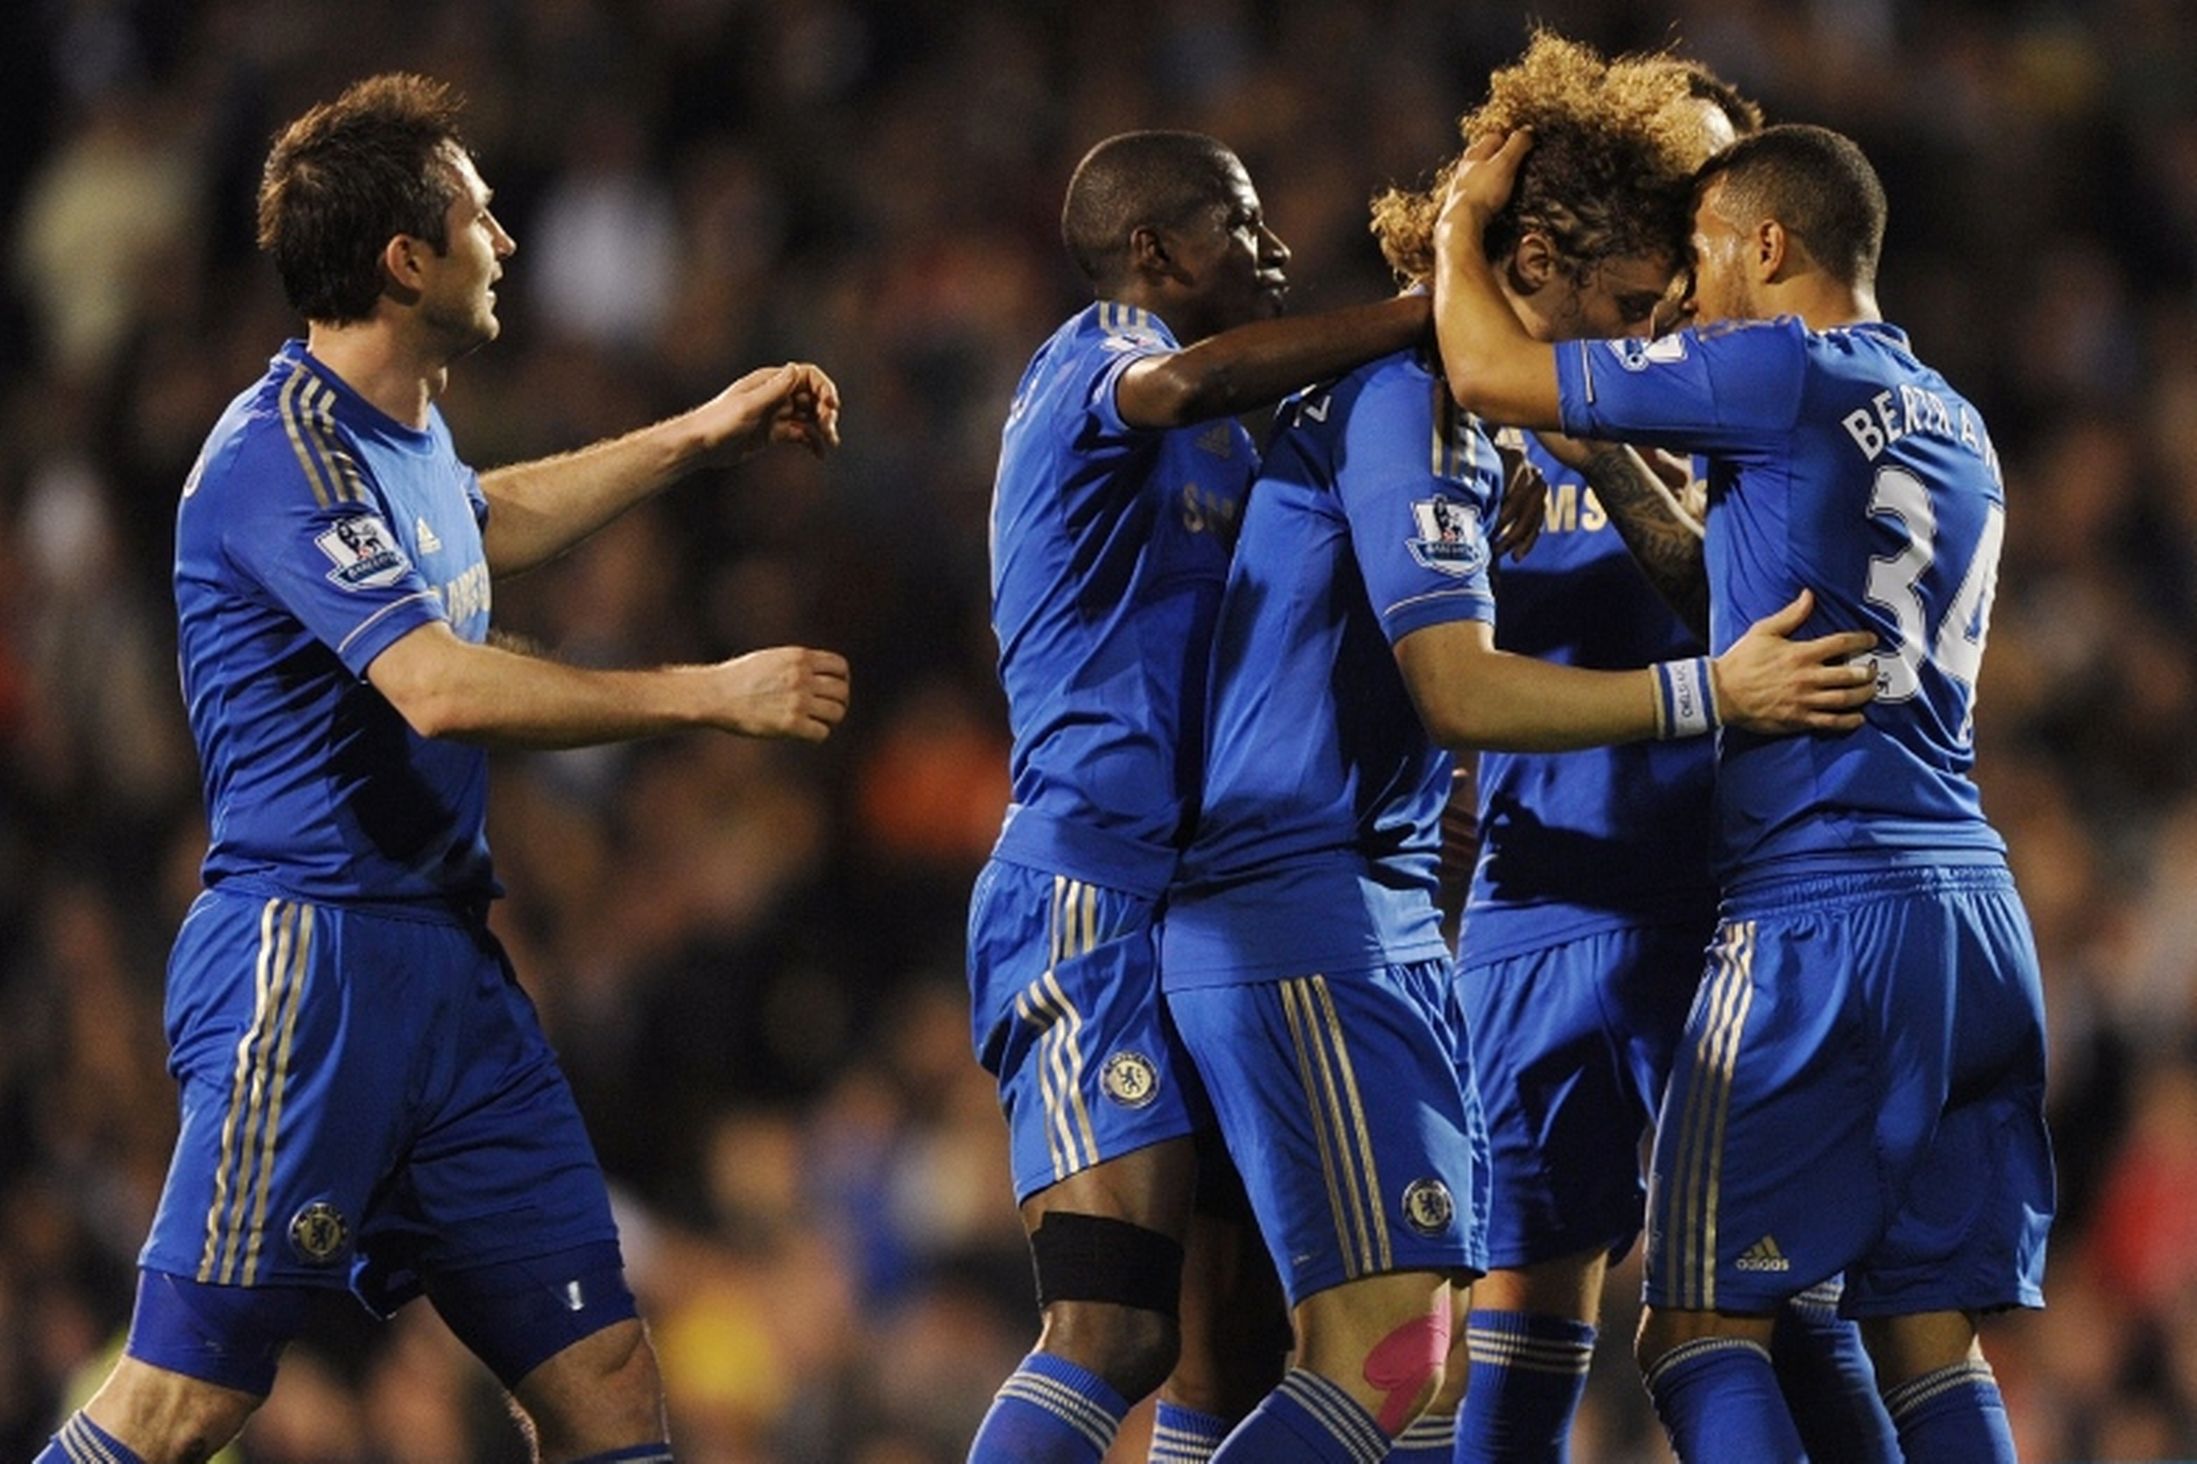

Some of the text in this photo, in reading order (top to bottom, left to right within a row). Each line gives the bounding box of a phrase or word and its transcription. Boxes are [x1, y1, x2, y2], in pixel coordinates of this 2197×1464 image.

[1544, 484, 1607, 534] MS
[1851, 464, 2005, 706] 34
[1736, 1256, 1789, 1271] adidas
